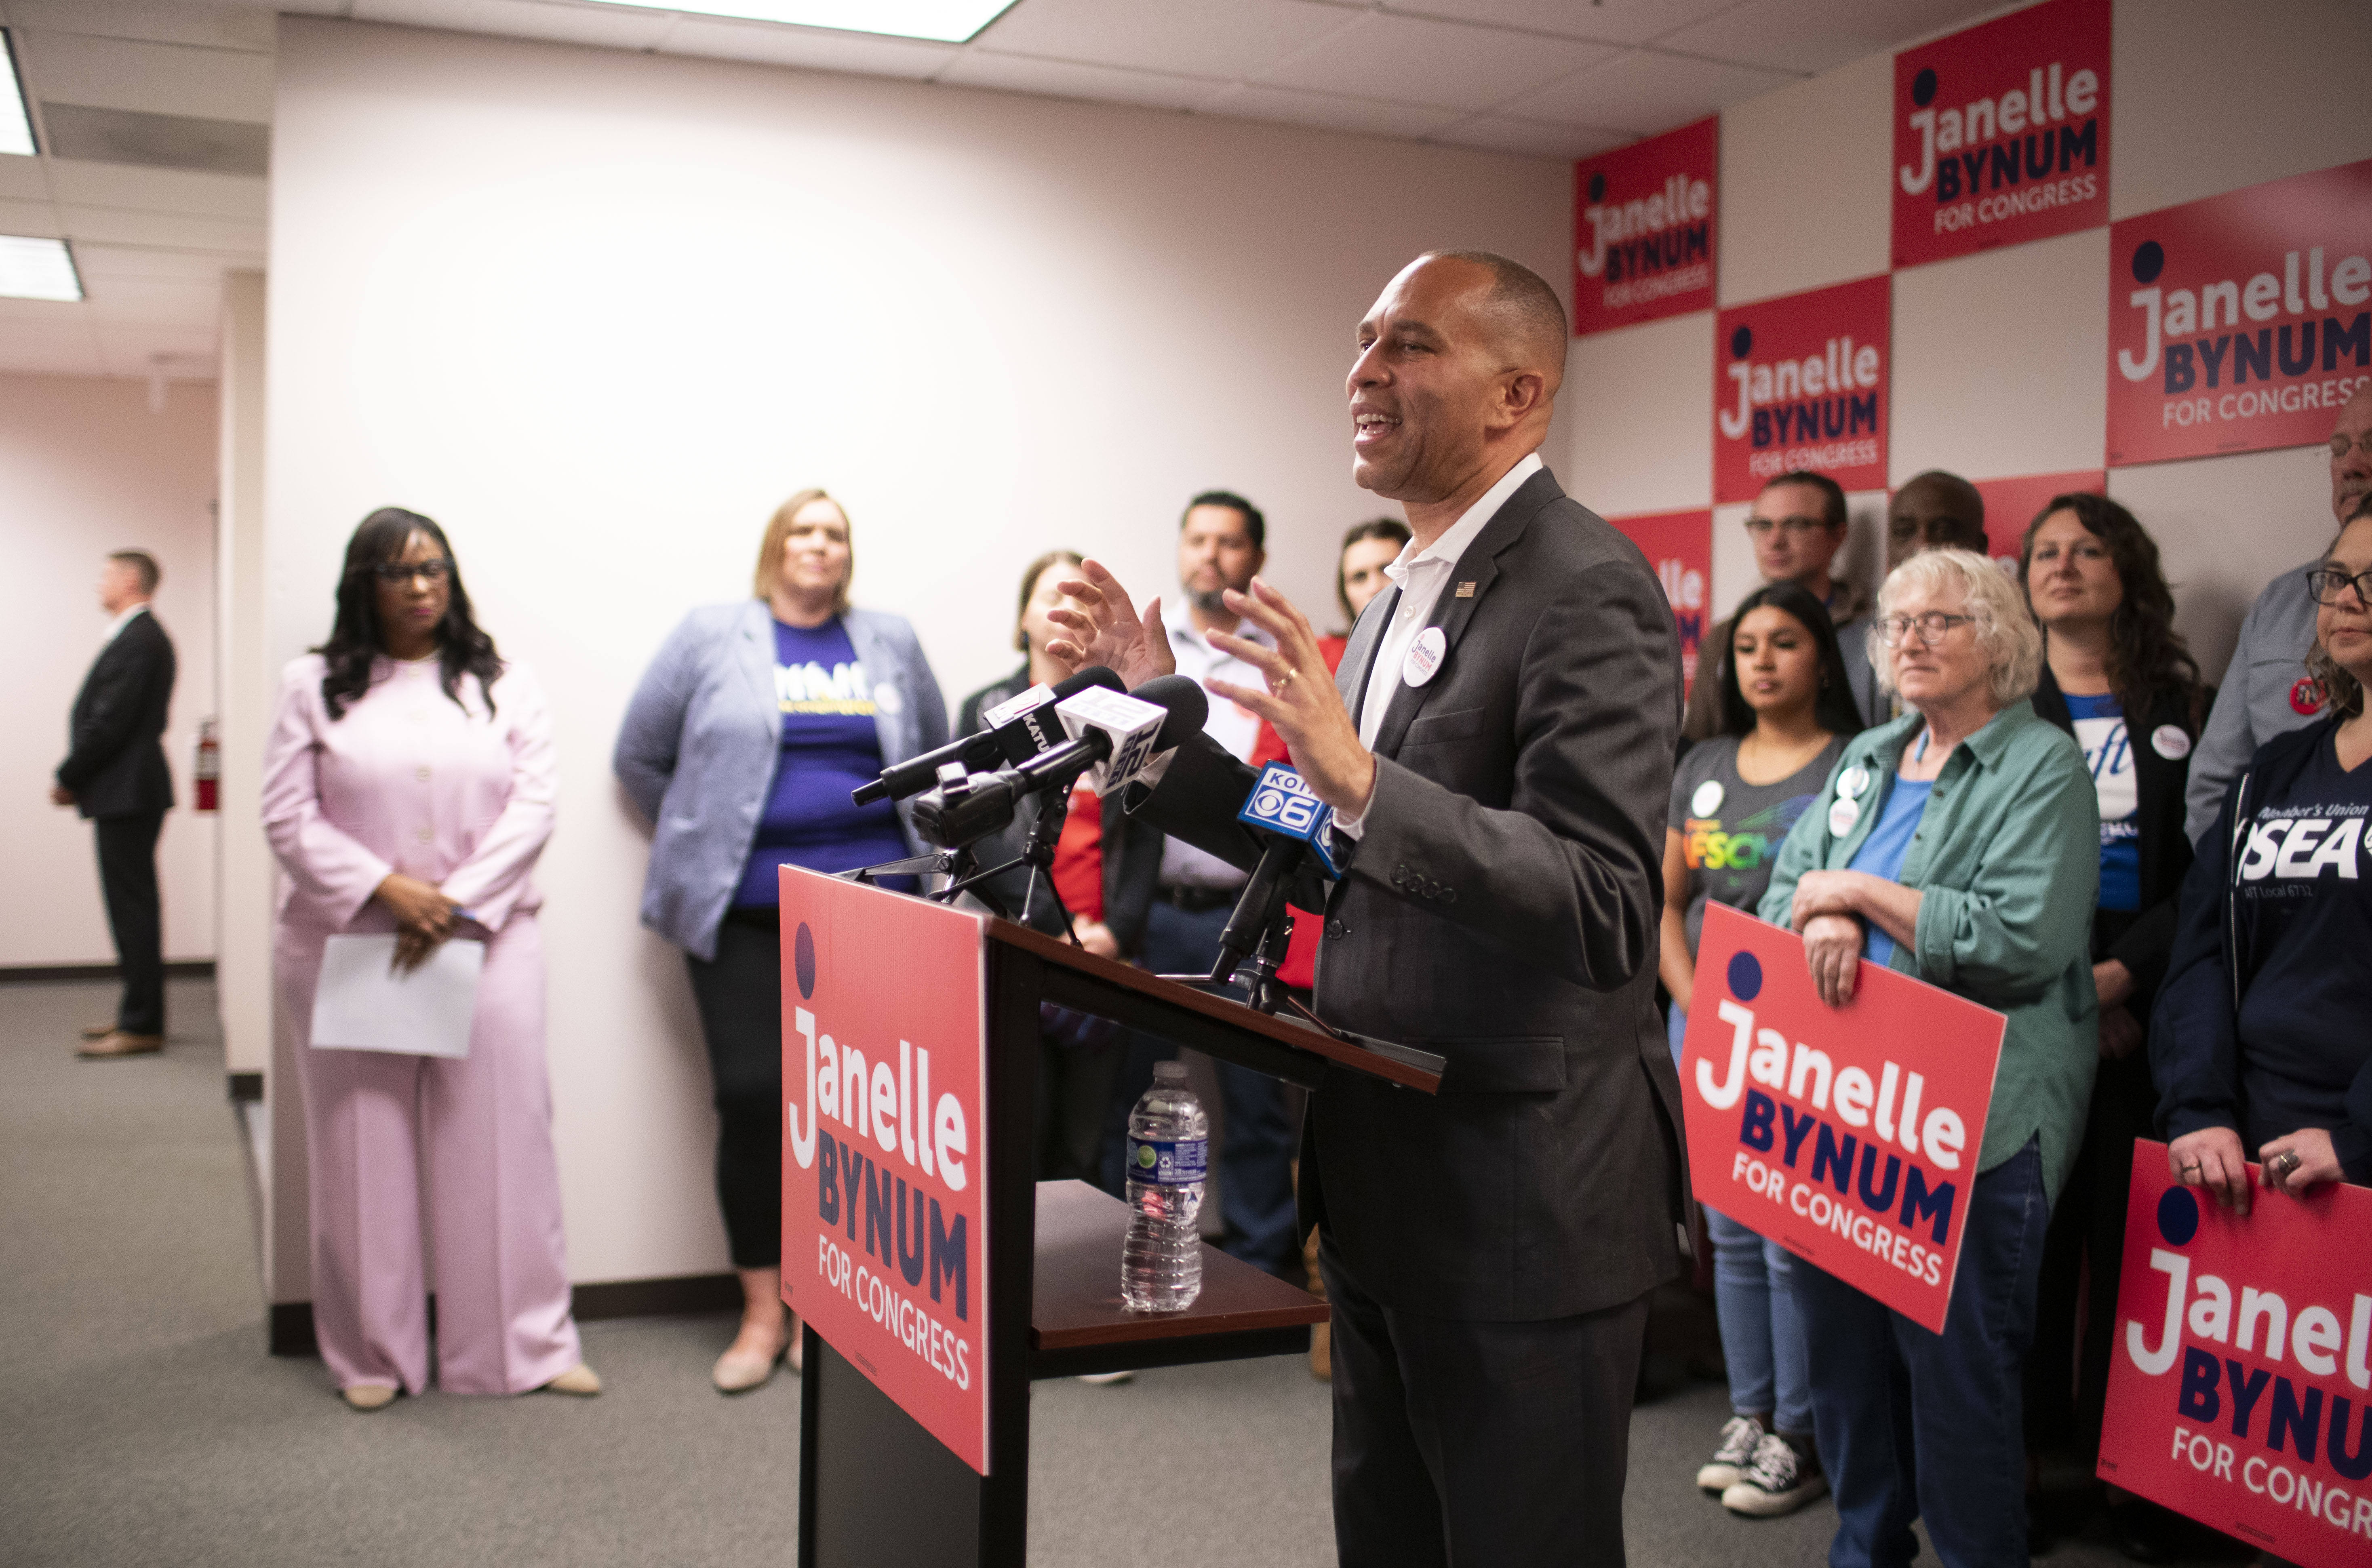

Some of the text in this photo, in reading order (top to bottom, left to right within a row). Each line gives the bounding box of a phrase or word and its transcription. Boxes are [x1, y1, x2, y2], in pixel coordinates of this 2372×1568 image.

[1938, 119, 2096, 203] BYNUM
[1934, 174, 2096, 234] FOR CONGRESS
[1606, 221, 1707, 282] BYNUM
[2165, 312, 2370, 395] BYNUM
[1752, 390, 1877, 447] BYNUM
[2163, 398, 2211, 427] FOR
[1413, 650, 1432, 671] BYNUM
[1023, 713, 1050, 753] KATU
[1118, 721, 1160, 782] 12
[1270, 772, 1312, 795] KOI
[2325, 803, 2369, 817] Union
[2260, 885, 2286, 898] Local
[2288, 884, 2313, 897] 6732
[1739, 1088, 1956, 1246] BYNUM
[819, 1128, 967, 1323] BYNUM
[1732, 1152, 1943, 1286] FOR CONGRESS
[819, 1233, 968, 1390] FOR CONGRESS
[2172, 1426, 2372, 1539] FOR CONGR
